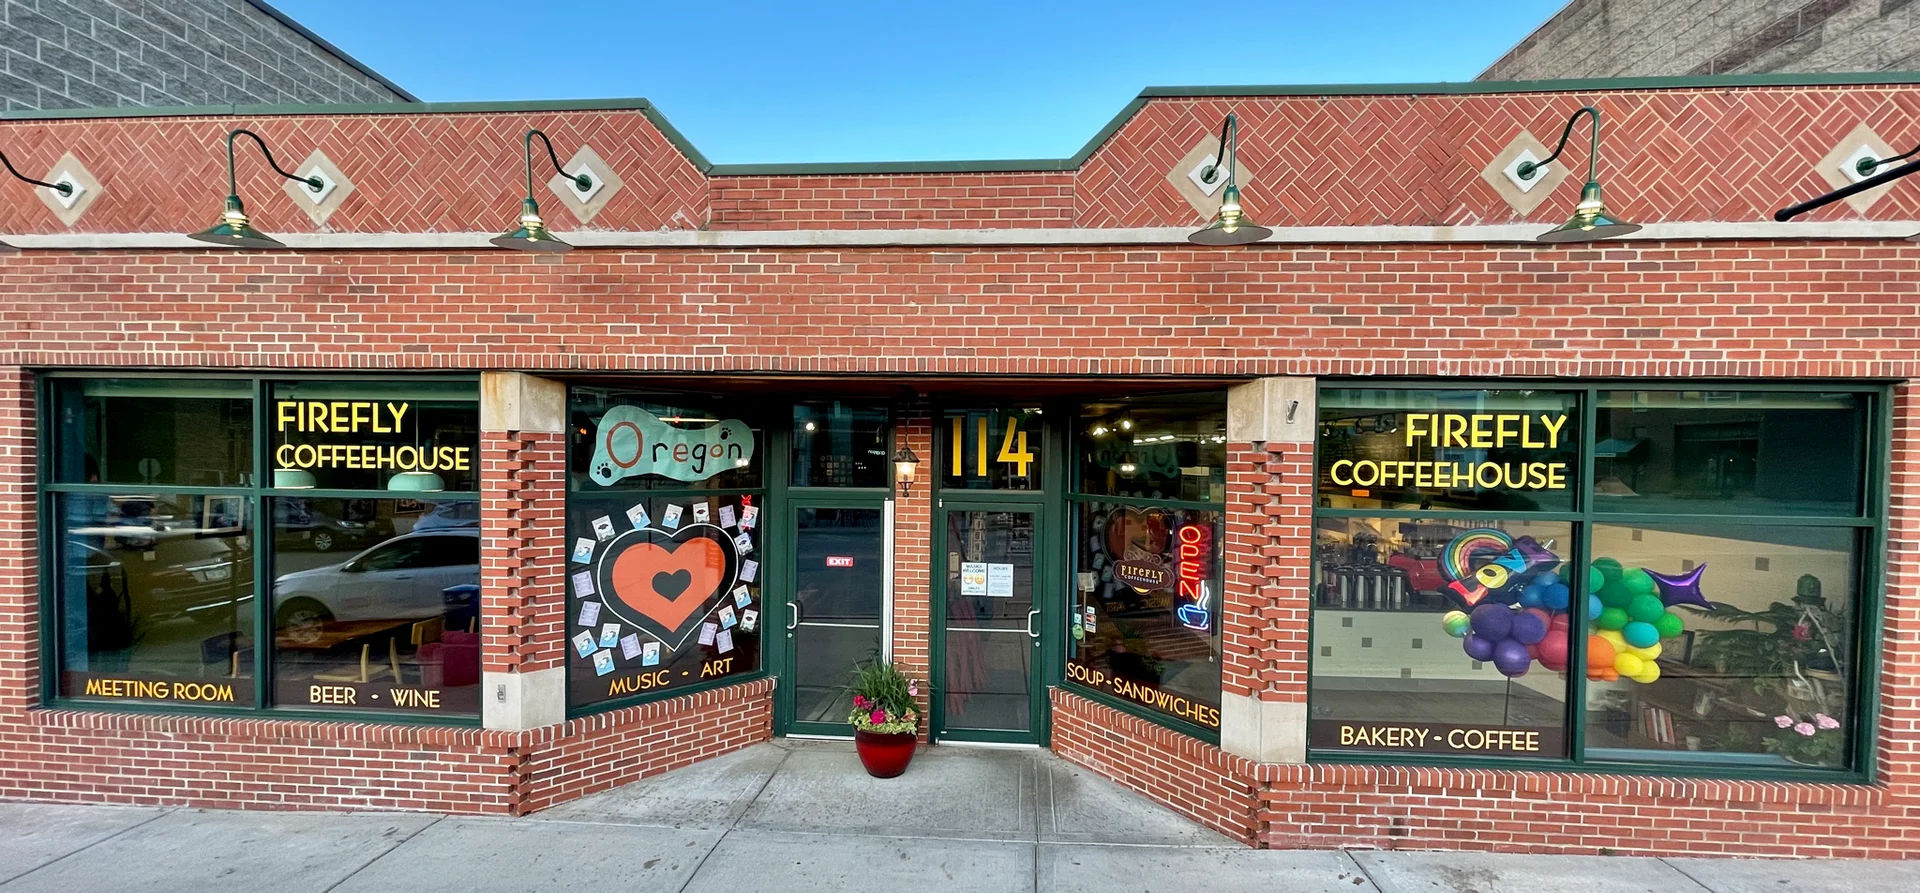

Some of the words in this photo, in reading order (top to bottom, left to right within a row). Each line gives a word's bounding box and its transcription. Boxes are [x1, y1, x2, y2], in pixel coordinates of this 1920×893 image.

[276, 401, 409, 433] FIREFLY
[1405, 413, 1567, 449] FIREFLY
[276, 443, 470, 471] COFFEEHOUSE
[605, 421, 742, 474] Oregon
[952, 416, 1034, 477] 114
[1330, 459, 1566, 489] COFFEEHOUSE
[828, 558, 851, 566] EXIT
[1179, 526, 1201, 600] OPEN
[1124, 574, 1159, 585] COFFEEHOUSE
[85, 678, 171, 700] MEETING
[173, 682, 235, 702] ROOM
[609, 669, 670, 696] MUSIC
[700, 657, 733, 678] ART
[309, 685, 357, 705] BEER
[390, 688, 441, 708] WINE
[1067, 662, 1105, 687] SOUP
[1113, 677, 1220, 728] SANDWICHES
[1340, 725, 1430, 748] BAKERY
[1447, 728, 1540, 751] COFFEE
